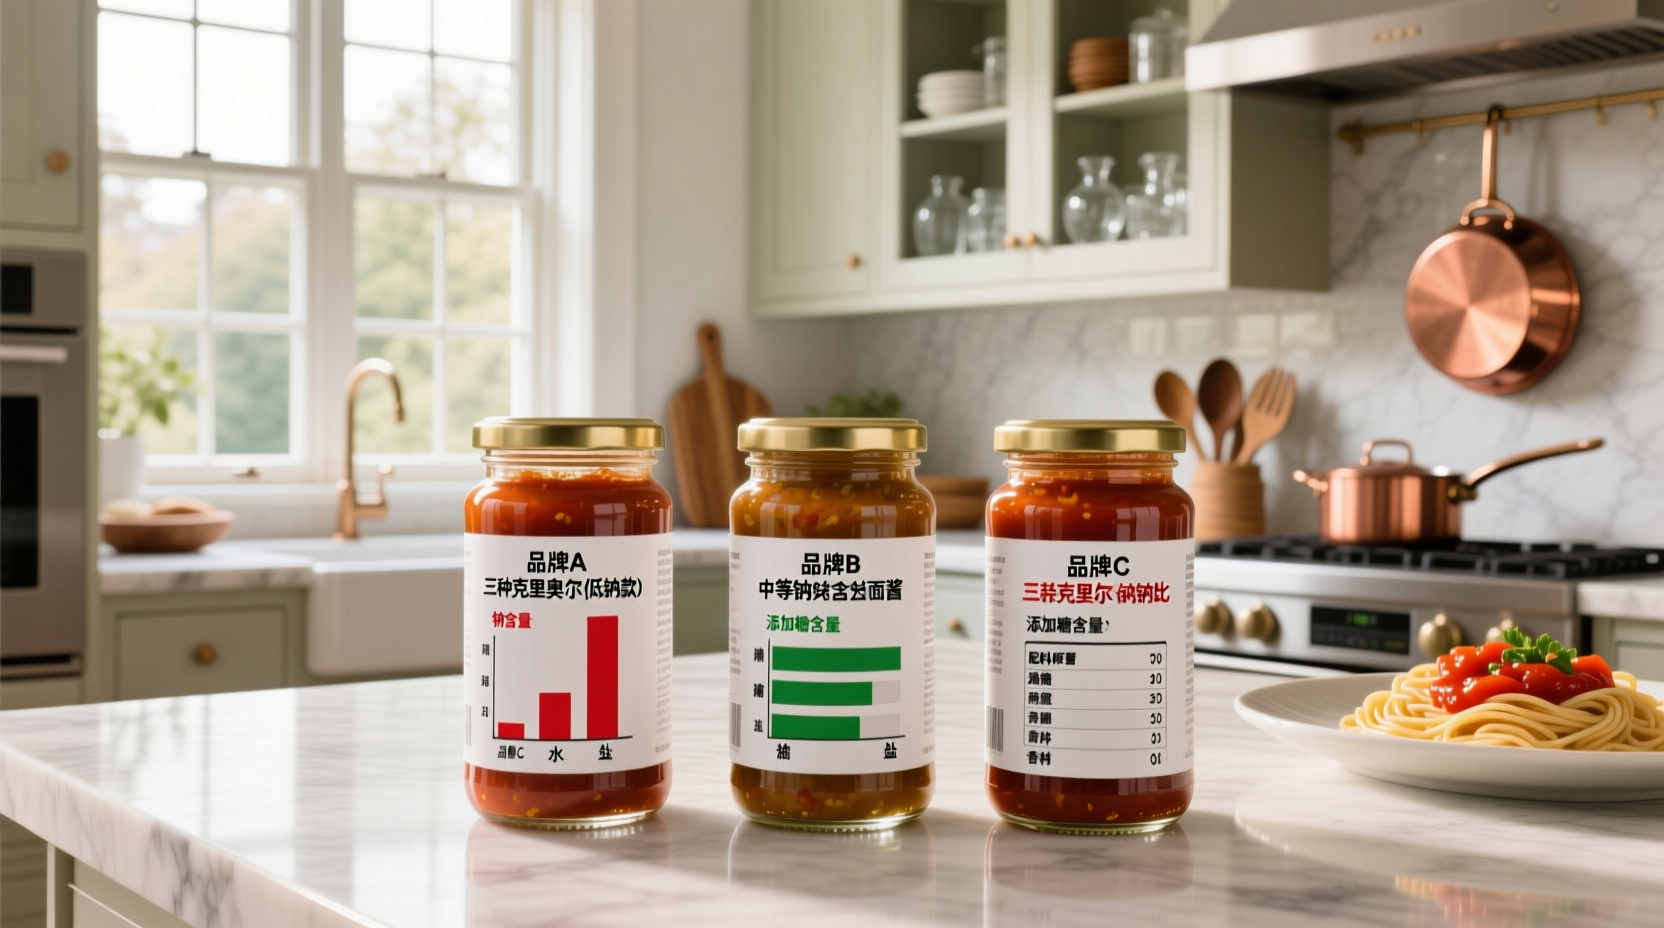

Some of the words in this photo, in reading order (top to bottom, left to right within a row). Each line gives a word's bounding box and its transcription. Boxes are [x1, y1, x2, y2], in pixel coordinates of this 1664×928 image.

[527, 550, 587, 573] 品牌A
[801, 552, 861, 576] 品牌B
[1067, 554, 1130, 578] 品牌C
[548, 745, 565, 763] 水
